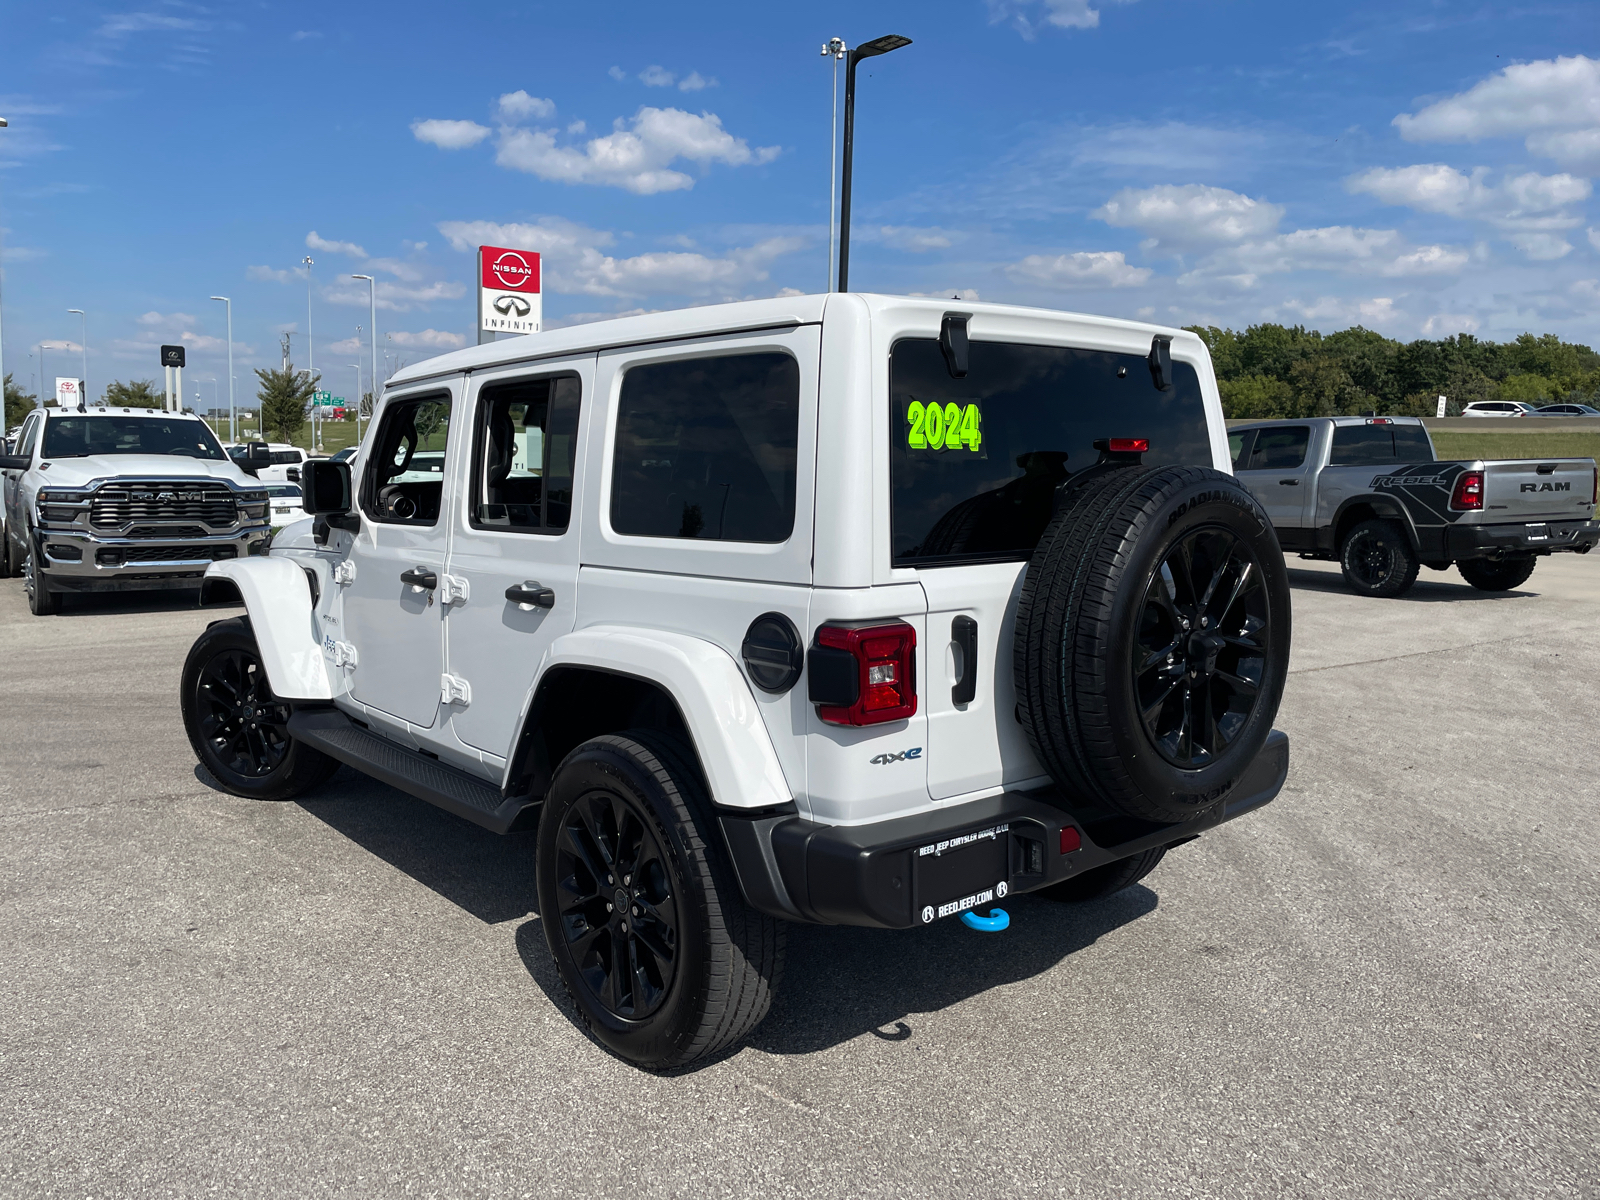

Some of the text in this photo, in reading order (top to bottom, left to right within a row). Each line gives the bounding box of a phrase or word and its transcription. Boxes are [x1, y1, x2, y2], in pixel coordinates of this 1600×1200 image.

[492, 263, 531, 275] NISSAN
[485, 318, 539, 331] INFINITI
[907, 400, 982, 452] 2024
[1368, 474, 1447, 488] REBEL
[1520, 482, 1571, 493] RAM
[131, 491, 201, 501] RAM
[919, 844, 935, 857] REED
[936, 840, 949, 851] JEEP
[949, 832, 977, 848] CHRYSLER
[938, 889, 993, 918] REEDJEEP.COM
